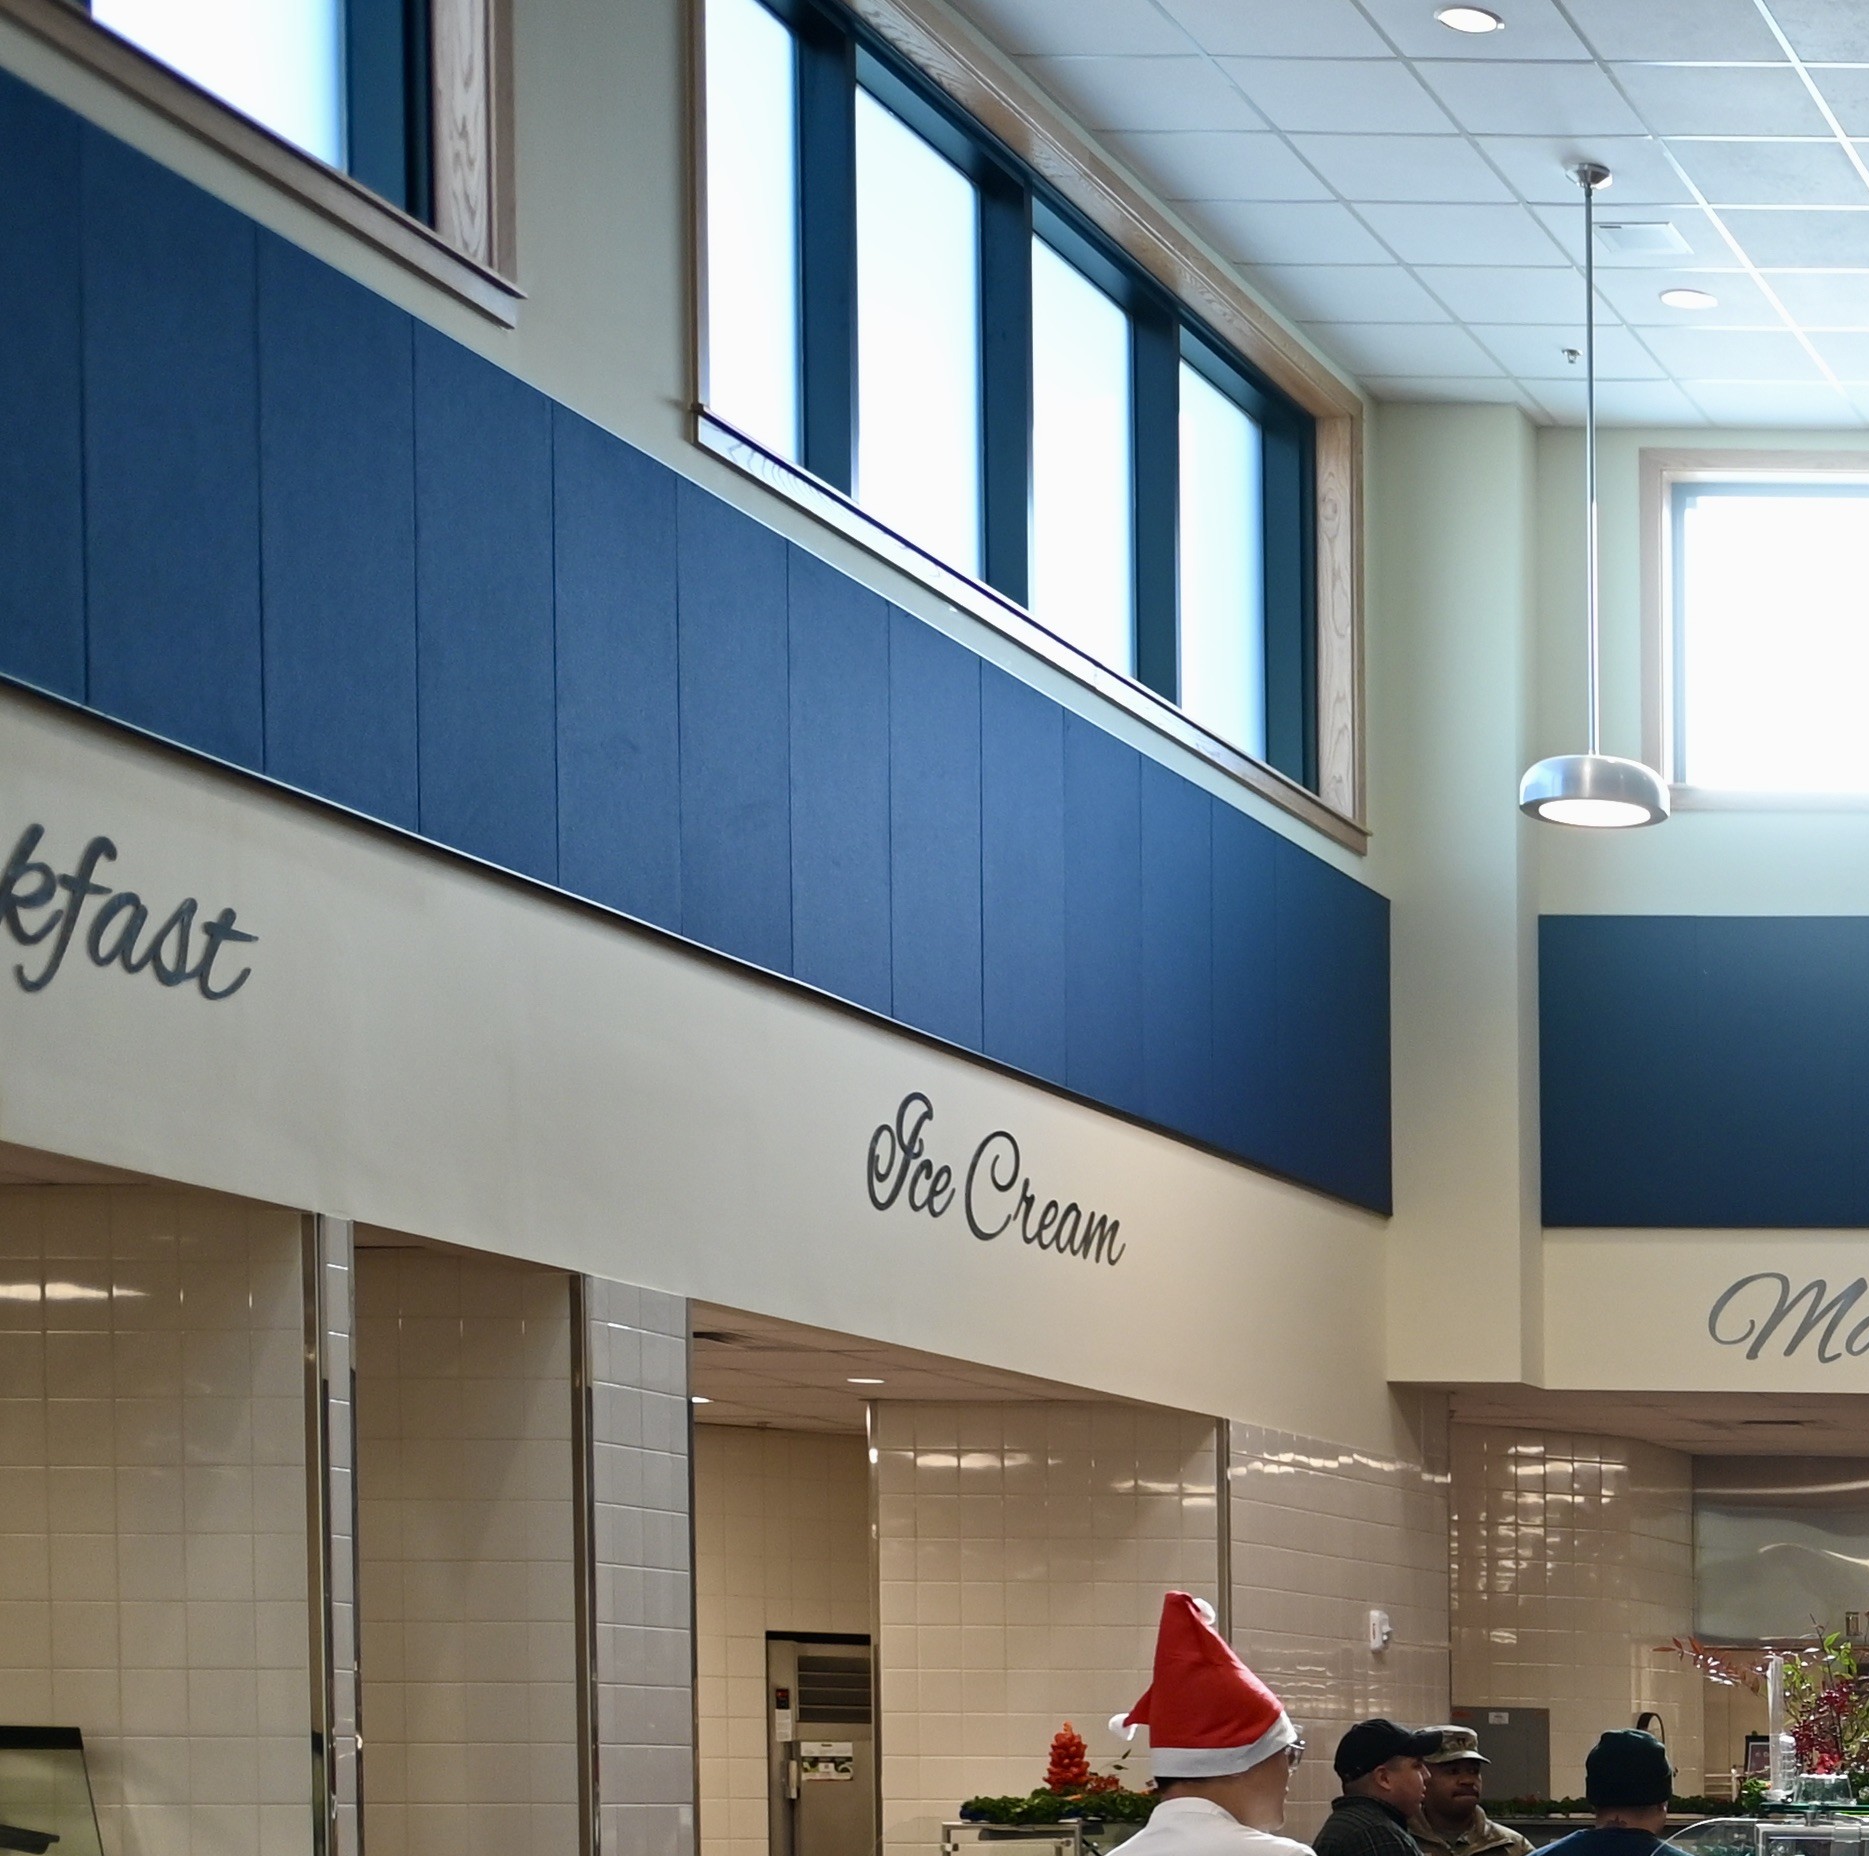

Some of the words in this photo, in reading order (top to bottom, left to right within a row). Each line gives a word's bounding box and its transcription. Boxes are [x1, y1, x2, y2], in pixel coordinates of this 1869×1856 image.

[0, 823, 259, 1001] kfast
[867, 1091, 955, 1218] Ice
[964, 1130, 1126, 1266] Cream
